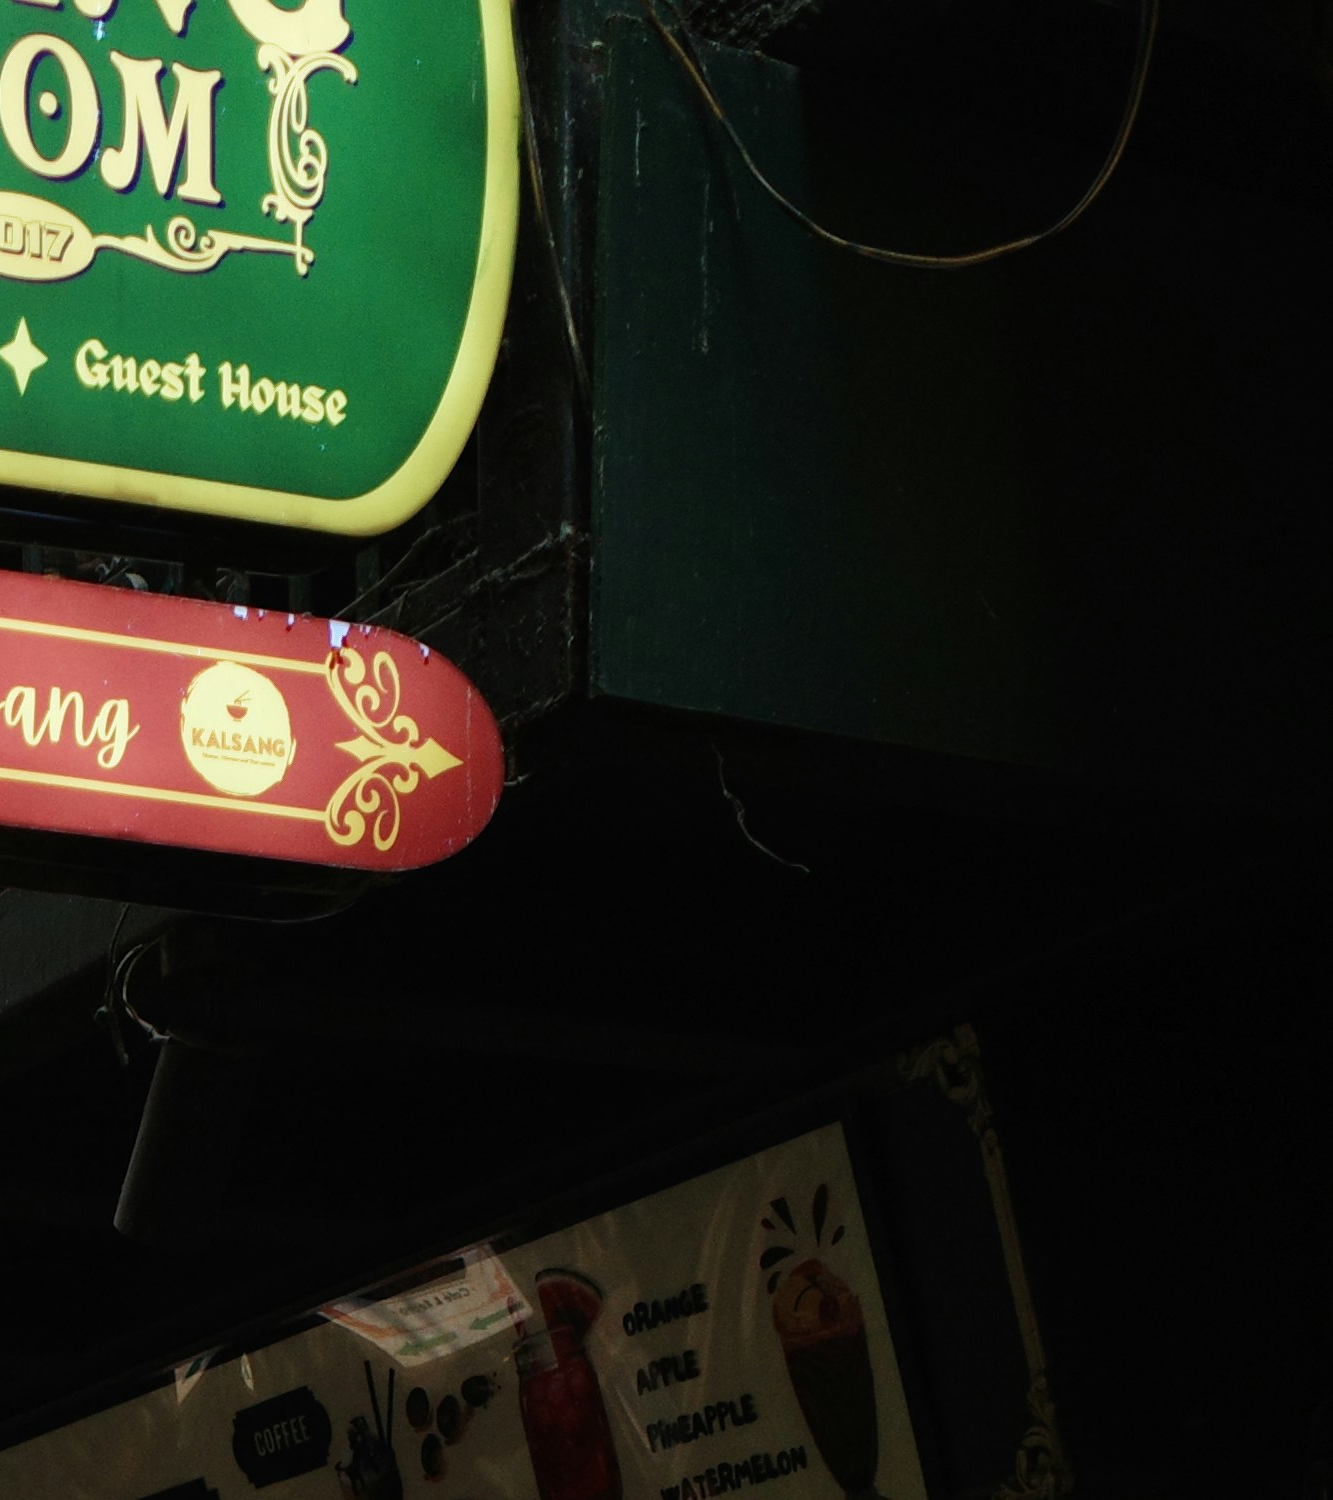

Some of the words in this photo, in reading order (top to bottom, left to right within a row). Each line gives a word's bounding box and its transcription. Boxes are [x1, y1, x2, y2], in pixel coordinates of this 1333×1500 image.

[75, 338, 206, 403] Guest
[218, 361, 347, 427] House
[191, 727, 286, 758] KALSANG
[636, 1350, 700, 1395] APPLE
[253, 1414, 312, 1457] COFFEE
